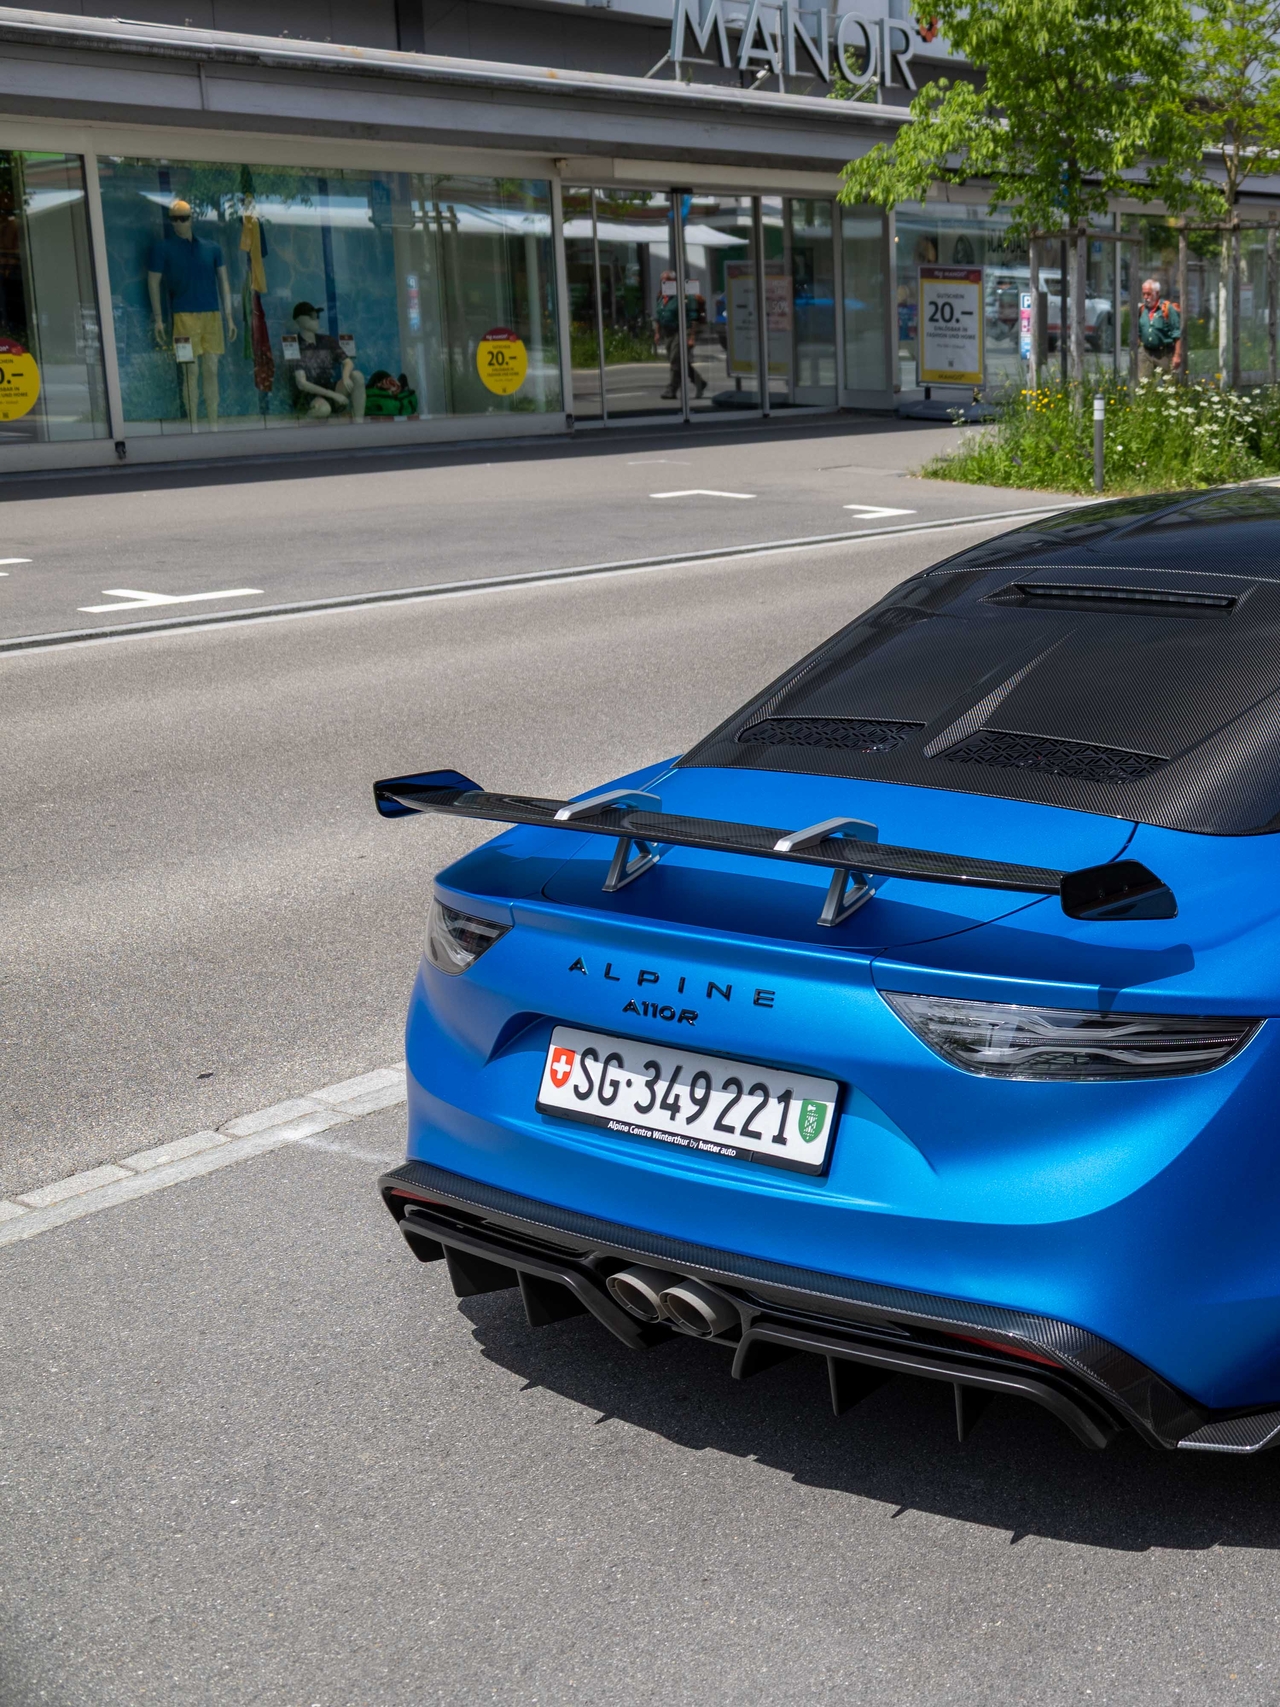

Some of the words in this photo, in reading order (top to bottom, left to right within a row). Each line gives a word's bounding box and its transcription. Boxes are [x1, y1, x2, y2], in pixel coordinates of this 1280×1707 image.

[670, 0, 917, 91] MANOR
[568, 955, 776, 1008] ALPINE
[622, 998, 699, 1026] A110R
[607, 1120, 629, 1133] Alpine
[630, 1125, 652, 1138] Centre
[652, 1130, 689, 1146] Winterthur
[689, 1139, 699, 1149] by
[698, 1140, 720, 1153] hutter
[720, 1146, 736, 1157] auto
